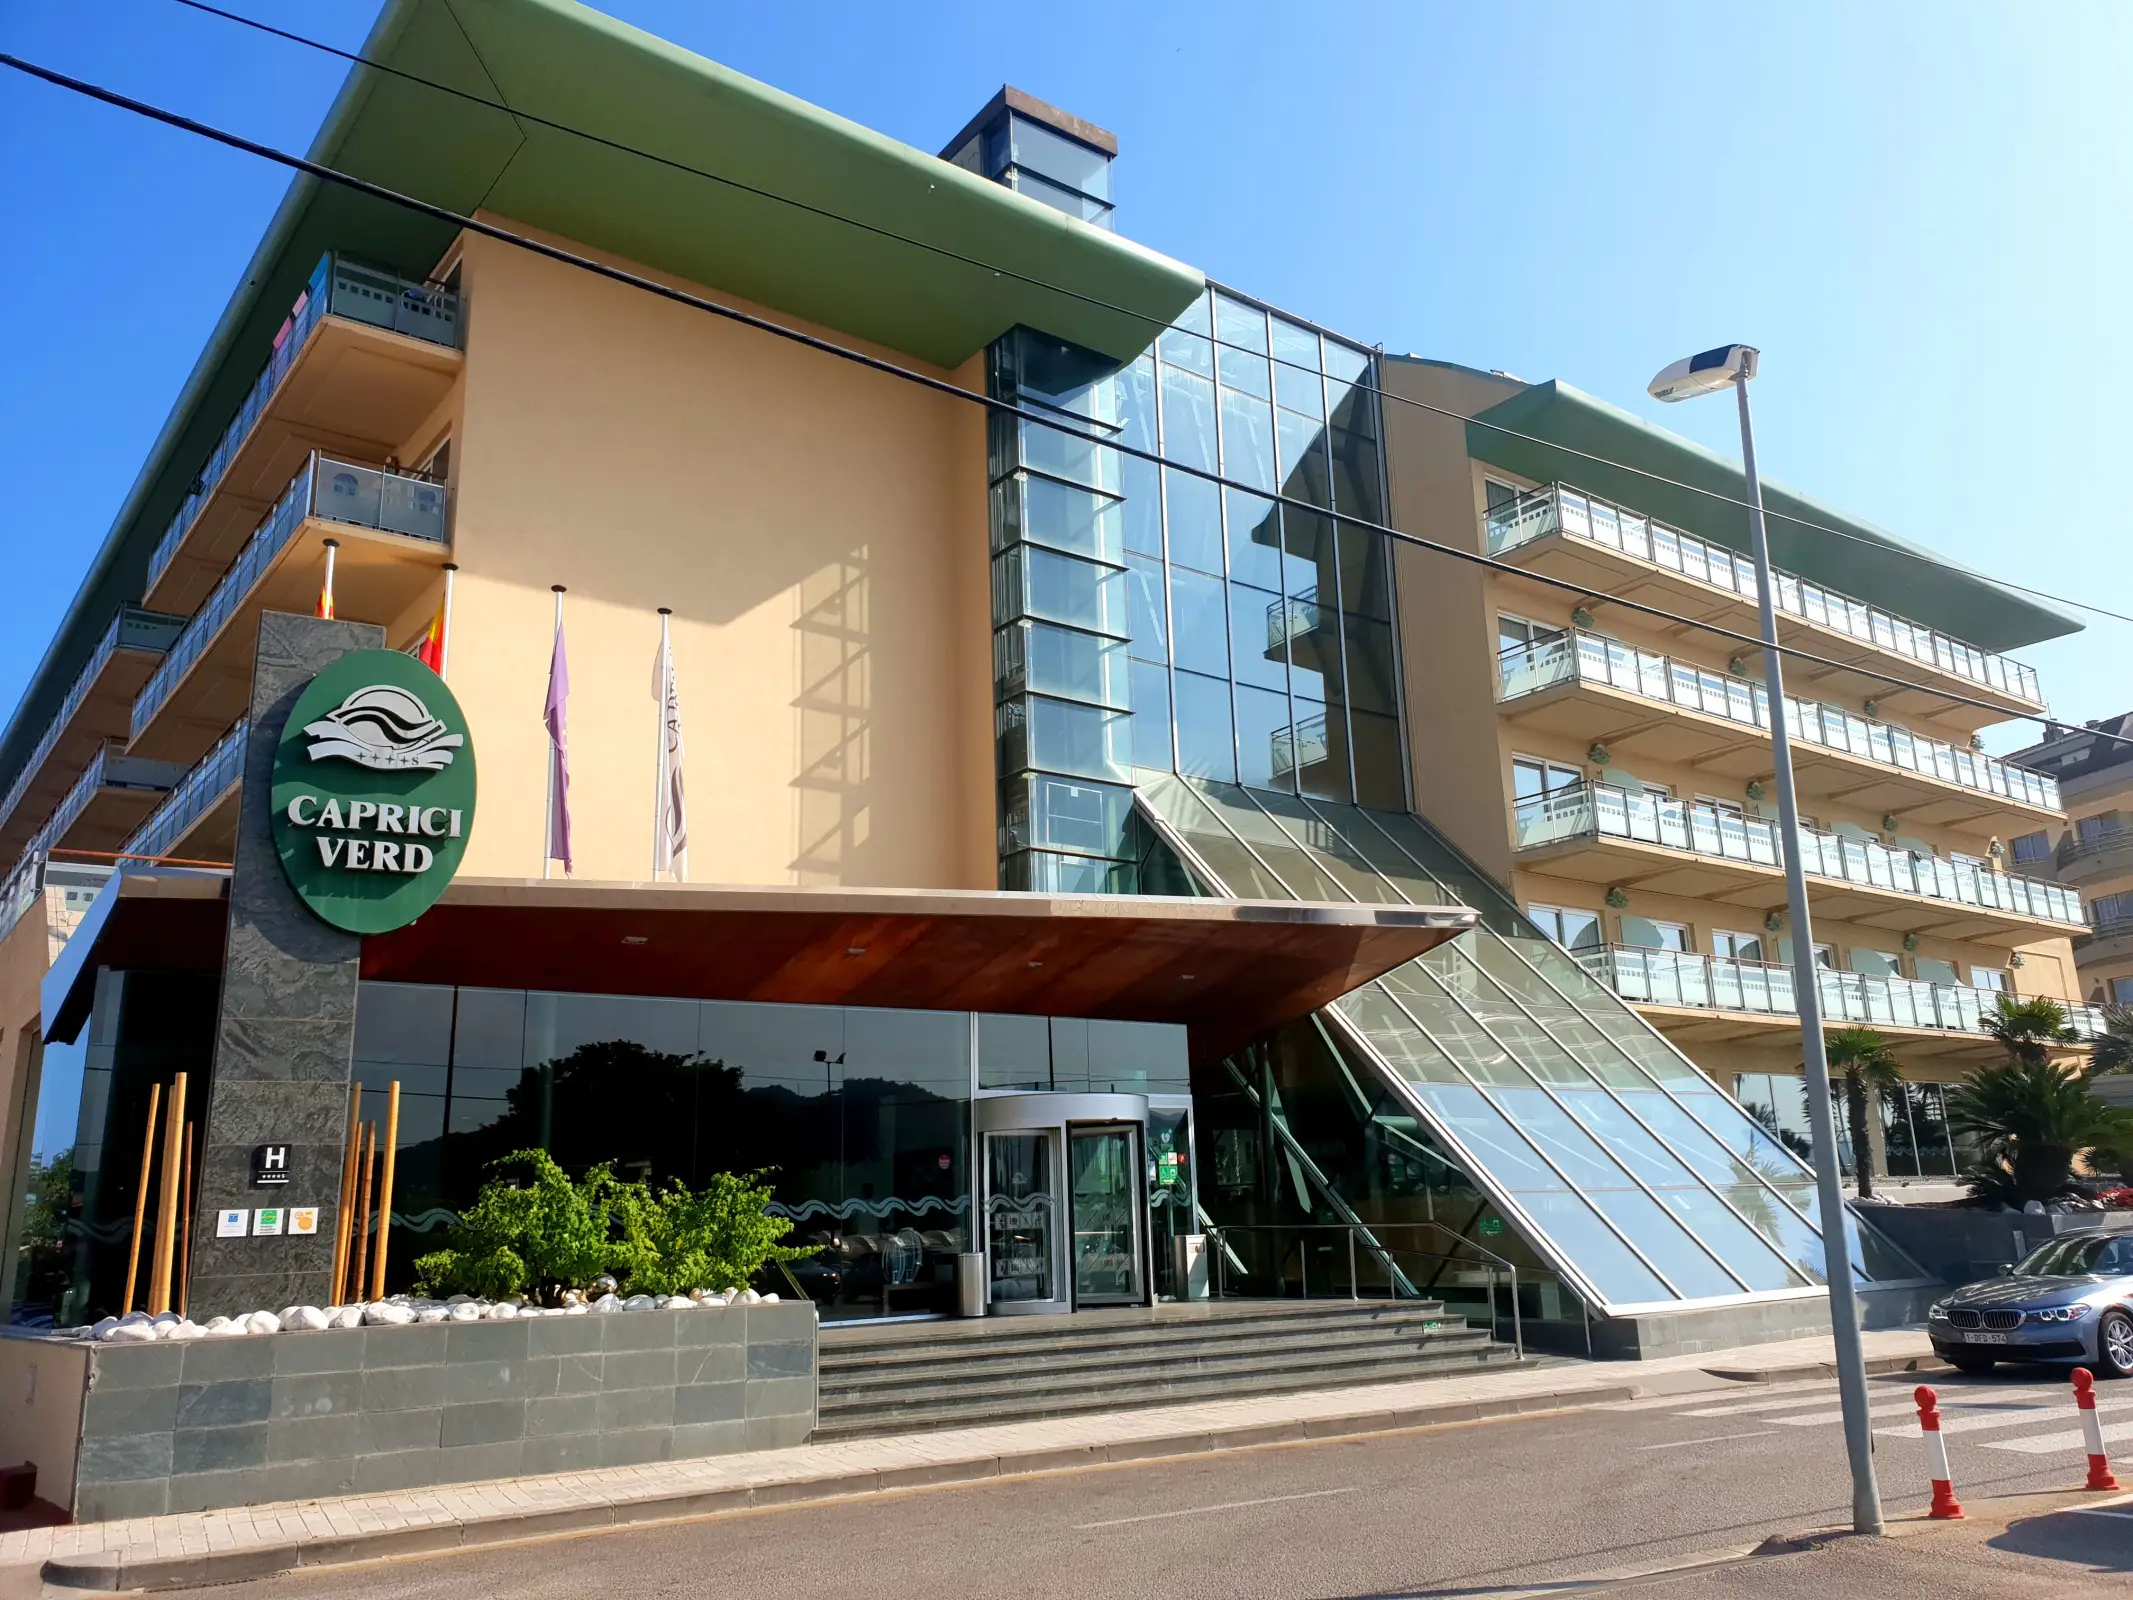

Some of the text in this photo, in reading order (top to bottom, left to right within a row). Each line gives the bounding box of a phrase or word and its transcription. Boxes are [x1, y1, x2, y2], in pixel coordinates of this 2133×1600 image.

[287, 795, 463, 838] CAPRICI
[315, 836, 434, 873] VERD
[265, 1147, 285, 1168] H
